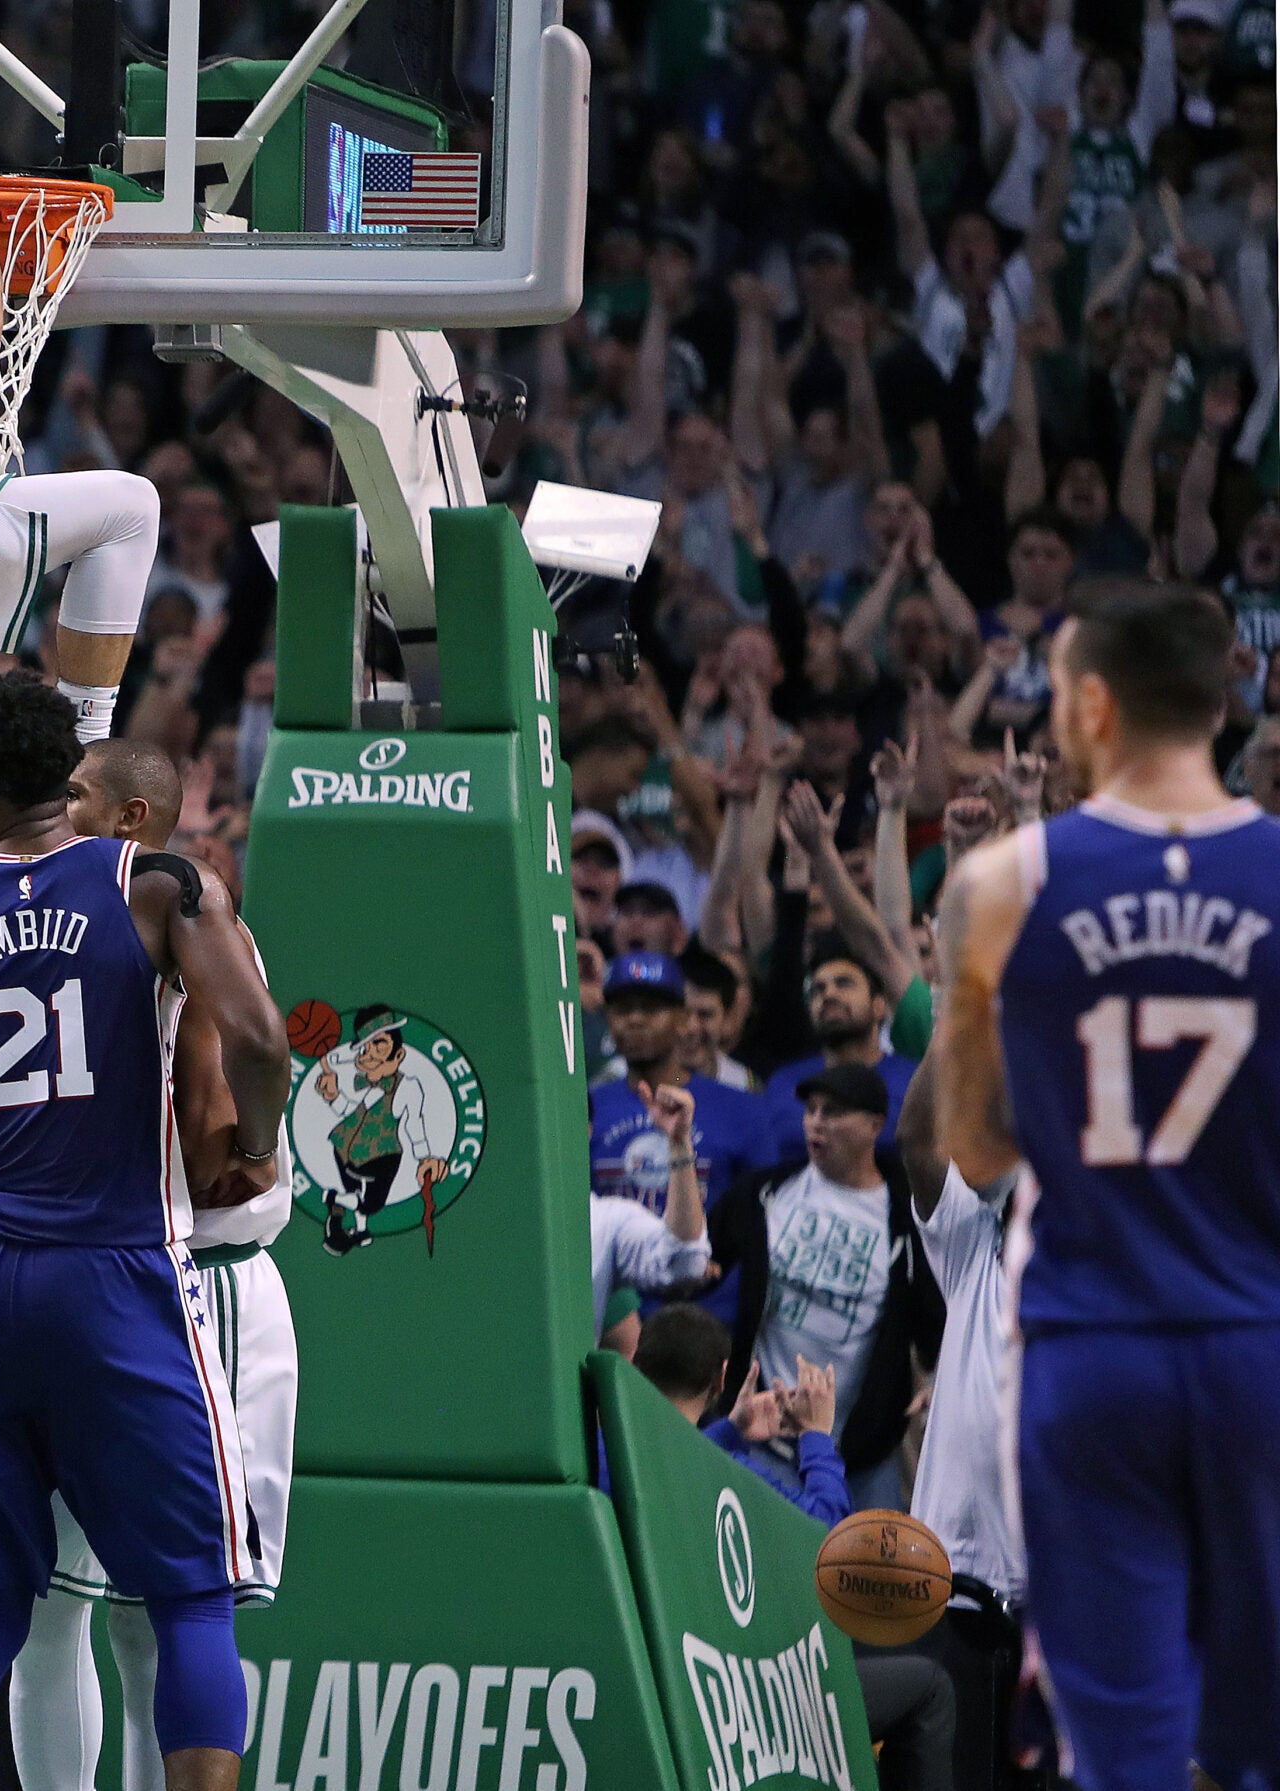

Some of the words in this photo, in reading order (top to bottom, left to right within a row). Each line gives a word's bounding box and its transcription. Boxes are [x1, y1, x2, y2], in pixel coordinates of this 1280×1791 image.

[288, 766, 472, 813] SPALDING
[1060, 889, 1273, 980] REDICK
[431, 1038, 484, 1179] CELTICS
[1075, 995, 1259, 1168] 17
[837, 1568, 931, 1601] SPALDING
[682, 1620, 852, 1791] SPALDING
